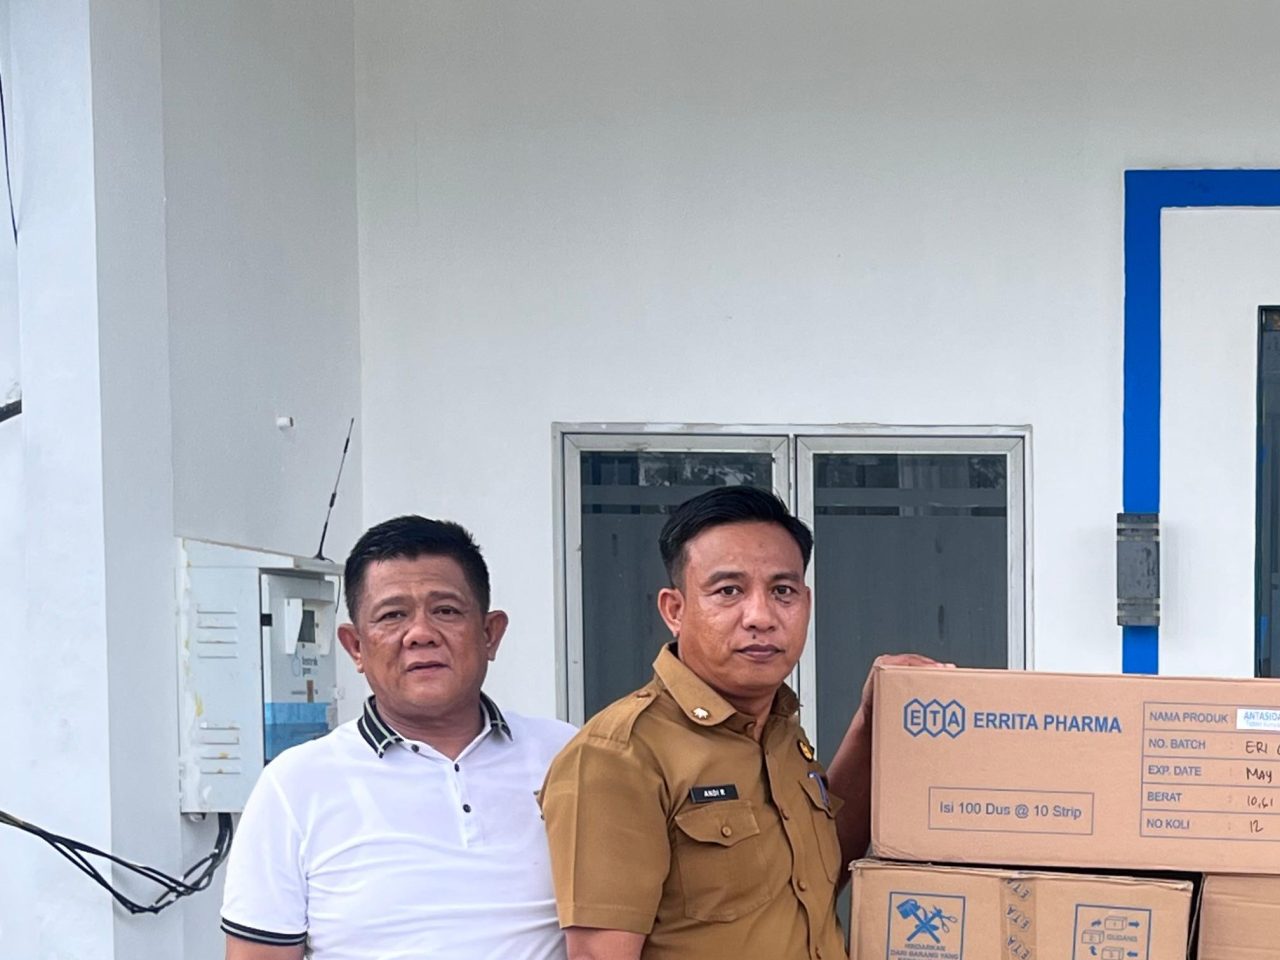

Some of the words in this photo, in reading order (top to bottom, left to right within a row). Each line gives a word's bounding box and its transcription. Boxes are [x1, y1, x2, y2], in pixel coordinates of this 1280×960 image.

[908, 705, 962, 731] ETA
[974, 712, 1039, 730] ERRITA
[1044, 714, 1122, 733] PHARMA
[1150, 711, 1181, 722] NAMA
[1182, 712, 1229, 724] PRODUK
[1149, 738, 1168, 748] NO.
[1170, 739, 1206, 750] BATCH
[1148, 764, 1171, 775] EXP.
[1174, 765, 1202, 776] DATE
[1147, 792, 1182, 801] BERAT
[940, 801, 954, 813] Isi
[959, 802, 982, 815] 100
[985, 803, 1010, 816] Dus
[1015, 804, 1029, 819] @
[1034, 805, 1049, 816] 10
[1053, 805, 1081, 820] Strip
[1147, 819, 1163, 828] NO
[1165, 819, 1190, 829] KOLI
[1250, 820, 1263, 832] 12
